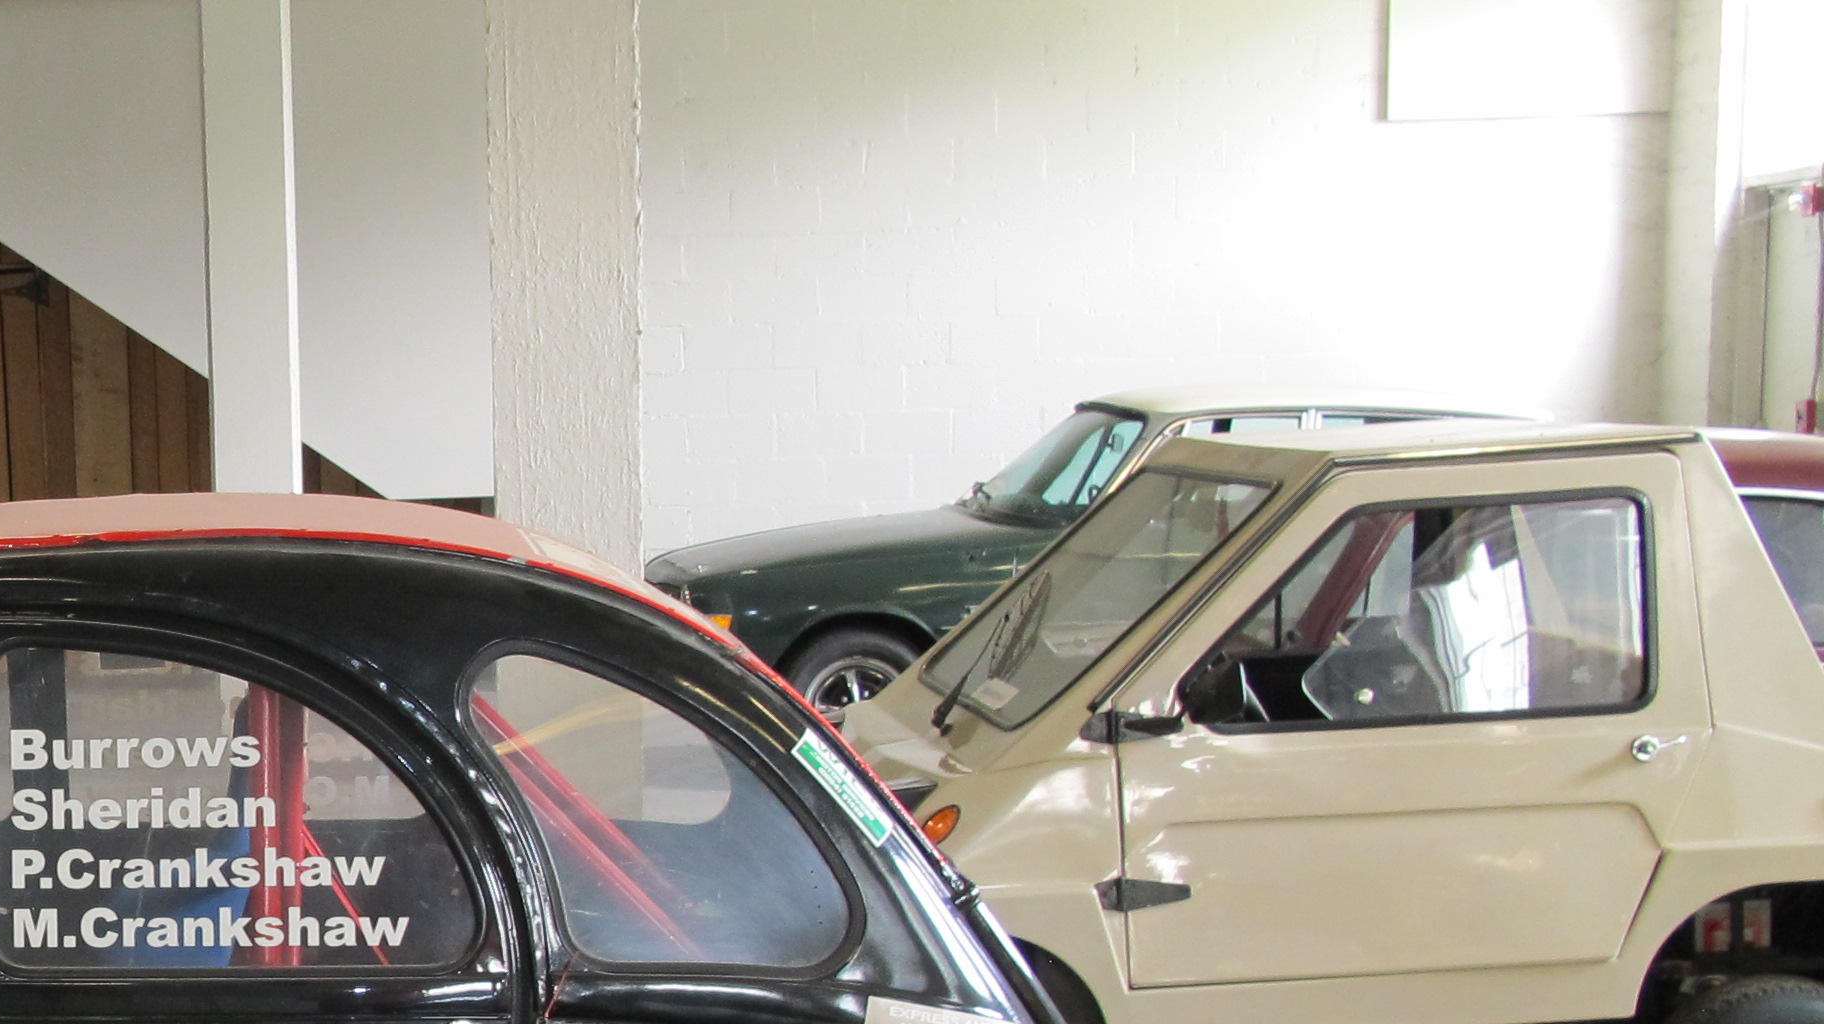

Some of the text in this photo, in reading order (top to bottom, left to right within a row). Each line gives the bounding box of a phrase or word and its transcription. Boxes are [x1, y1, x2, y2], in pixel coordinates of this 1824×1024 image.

[10, 729, 262, 770] Burrows
[11, 788, 276, 830] Sheridan
[11, 847, 386, 889] P.Crankshaw
[12, 907, 409, 948] M.Crankshaw
